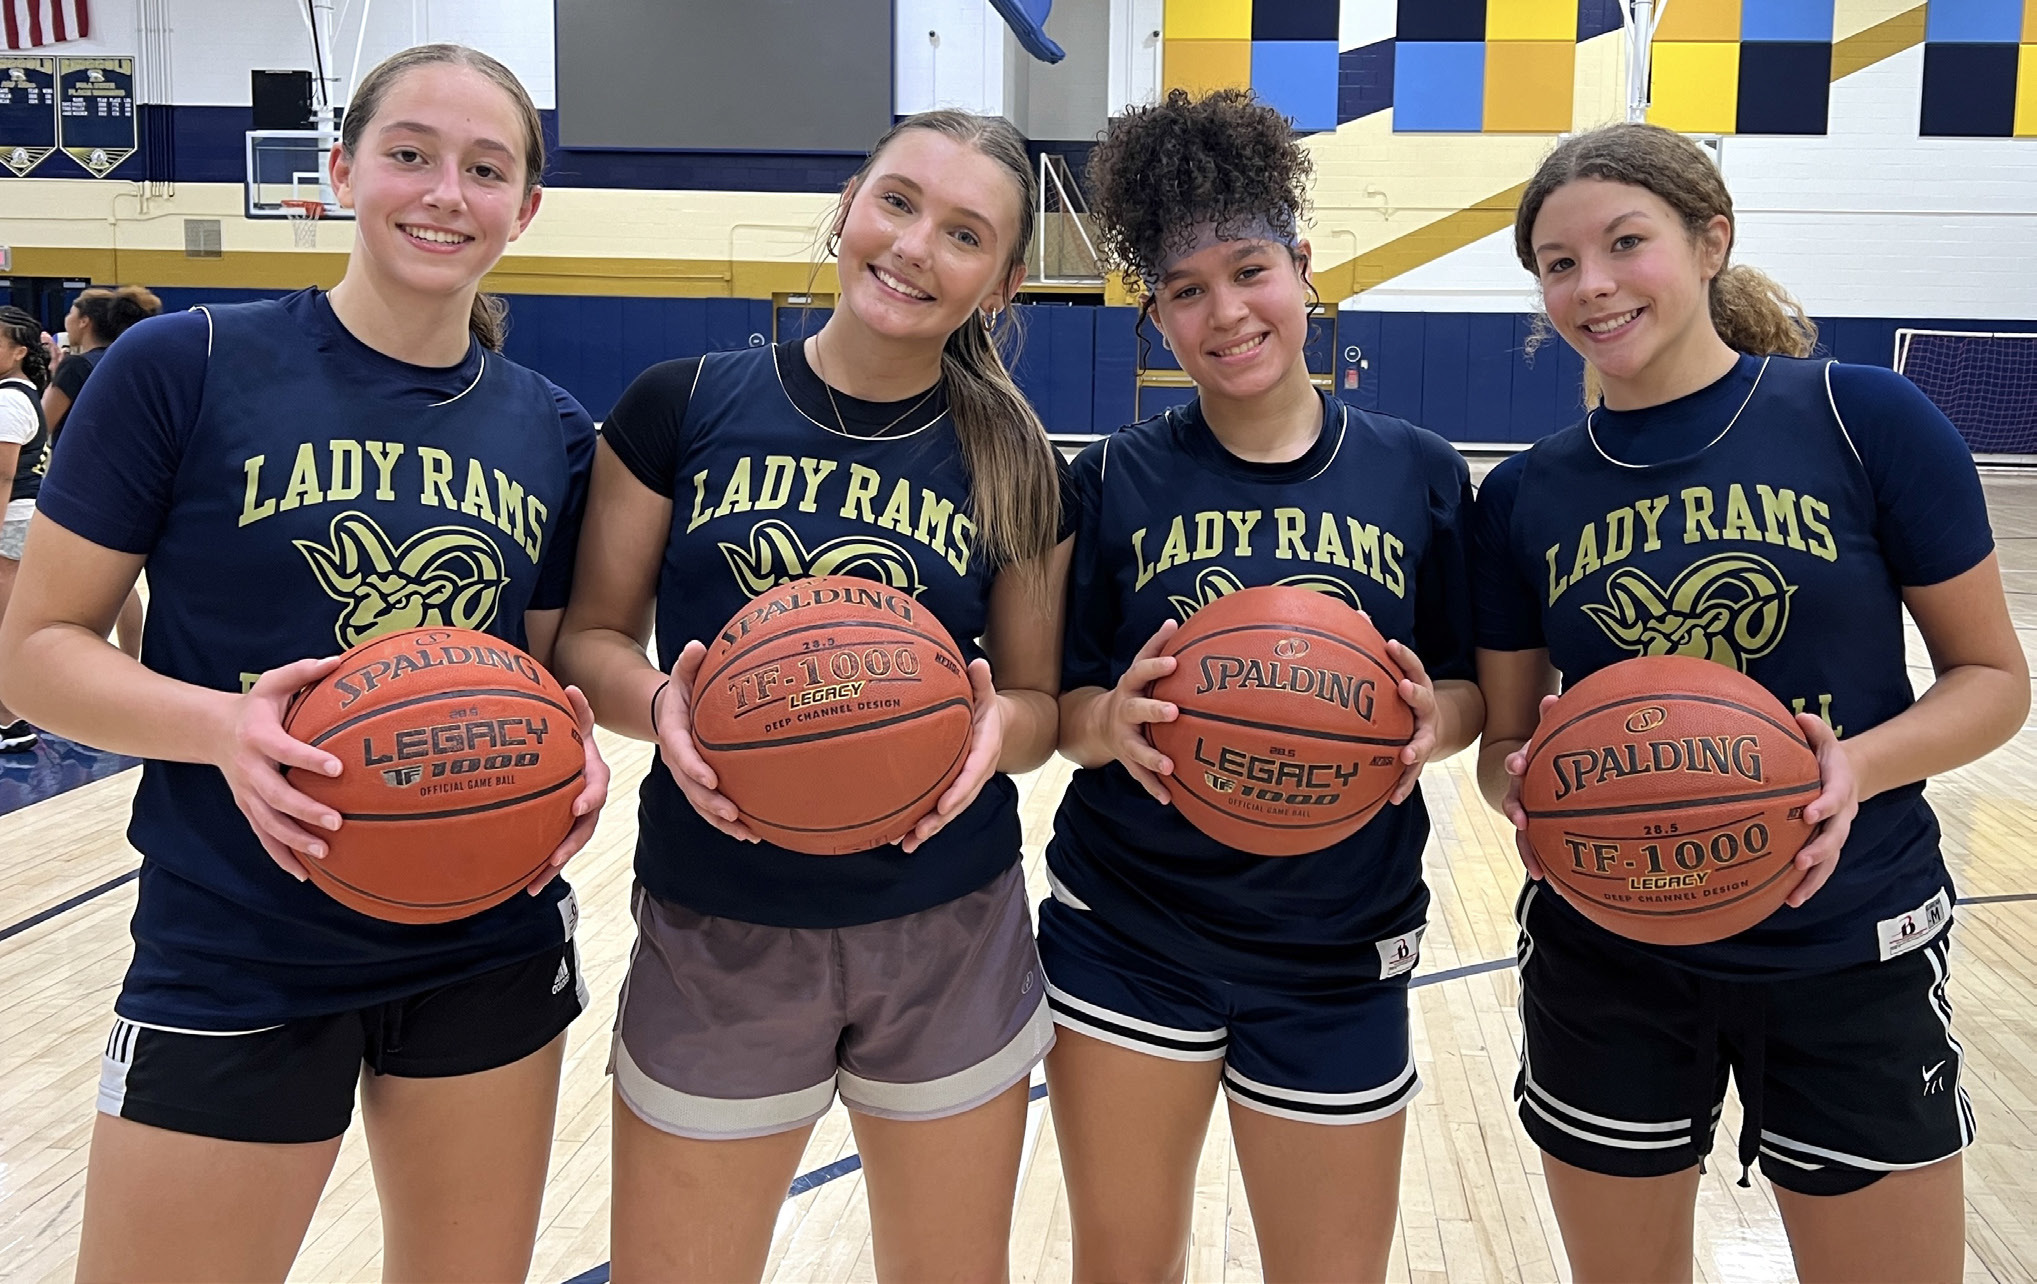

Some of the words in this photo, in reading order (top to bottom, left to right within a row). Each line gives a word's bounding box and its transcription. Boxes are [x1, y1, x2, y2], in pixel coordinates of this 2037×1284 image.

[238, 439, 404, 528] LADY
[418, 446, 548, 564] RAMS
[686, 455, 838, 534] LADY
[840, 463, 978, 577] RAMS
[1132, 510, 1262, 592] LADY
[1274, 507, 1405, 599] RAMS
[1546, 495, 1669, 607] LADY
[1681, 484, 1838, 562] RAMS
[721, 588, 915, 654] SPALDING
[333, 646, 542, 709] SPALDING
[728, 648, 920, 711] TF-1000
[788, 680, 866, 710] LEGACY
[1196, 654, 1376, 723] SPALDING
[363, 716, 549, 767] LEGACY
[764, 717, 792, 733] DEEP
[797, 705, 853, 722] CHANNEL
[857, 698, 901, 712] DESIGN
[383, 764, 423, 787] TF
[431, 751, 540, 779] 1000
[420, 781, 464, 797] OFFICIAL
[467, 776, 492, 791] GAME
[495, 774, 516, 786] BALL
[1194, 737, 1359, 790] LEGACY
[1552, 735, 1763, 801] SPALDING
[1228, 797, 1264, 813] OFFICIAL
[1266, 806, 1290, 817] GAME
[1292, 808, 1311, 818] BALL
[1241, 784, 1341, 806] 1000
[1564, 823, 1770, 875] TF-1000
[1643, 823, 1679, 836] 28.5
[1603, 892, 1632, 902] DEEP
[1638, 891, 1697, 903] CHANNEL
[1703, 879, 1749, 897] DESIGN
[1628, 869, 1712, 891] LEGACY
